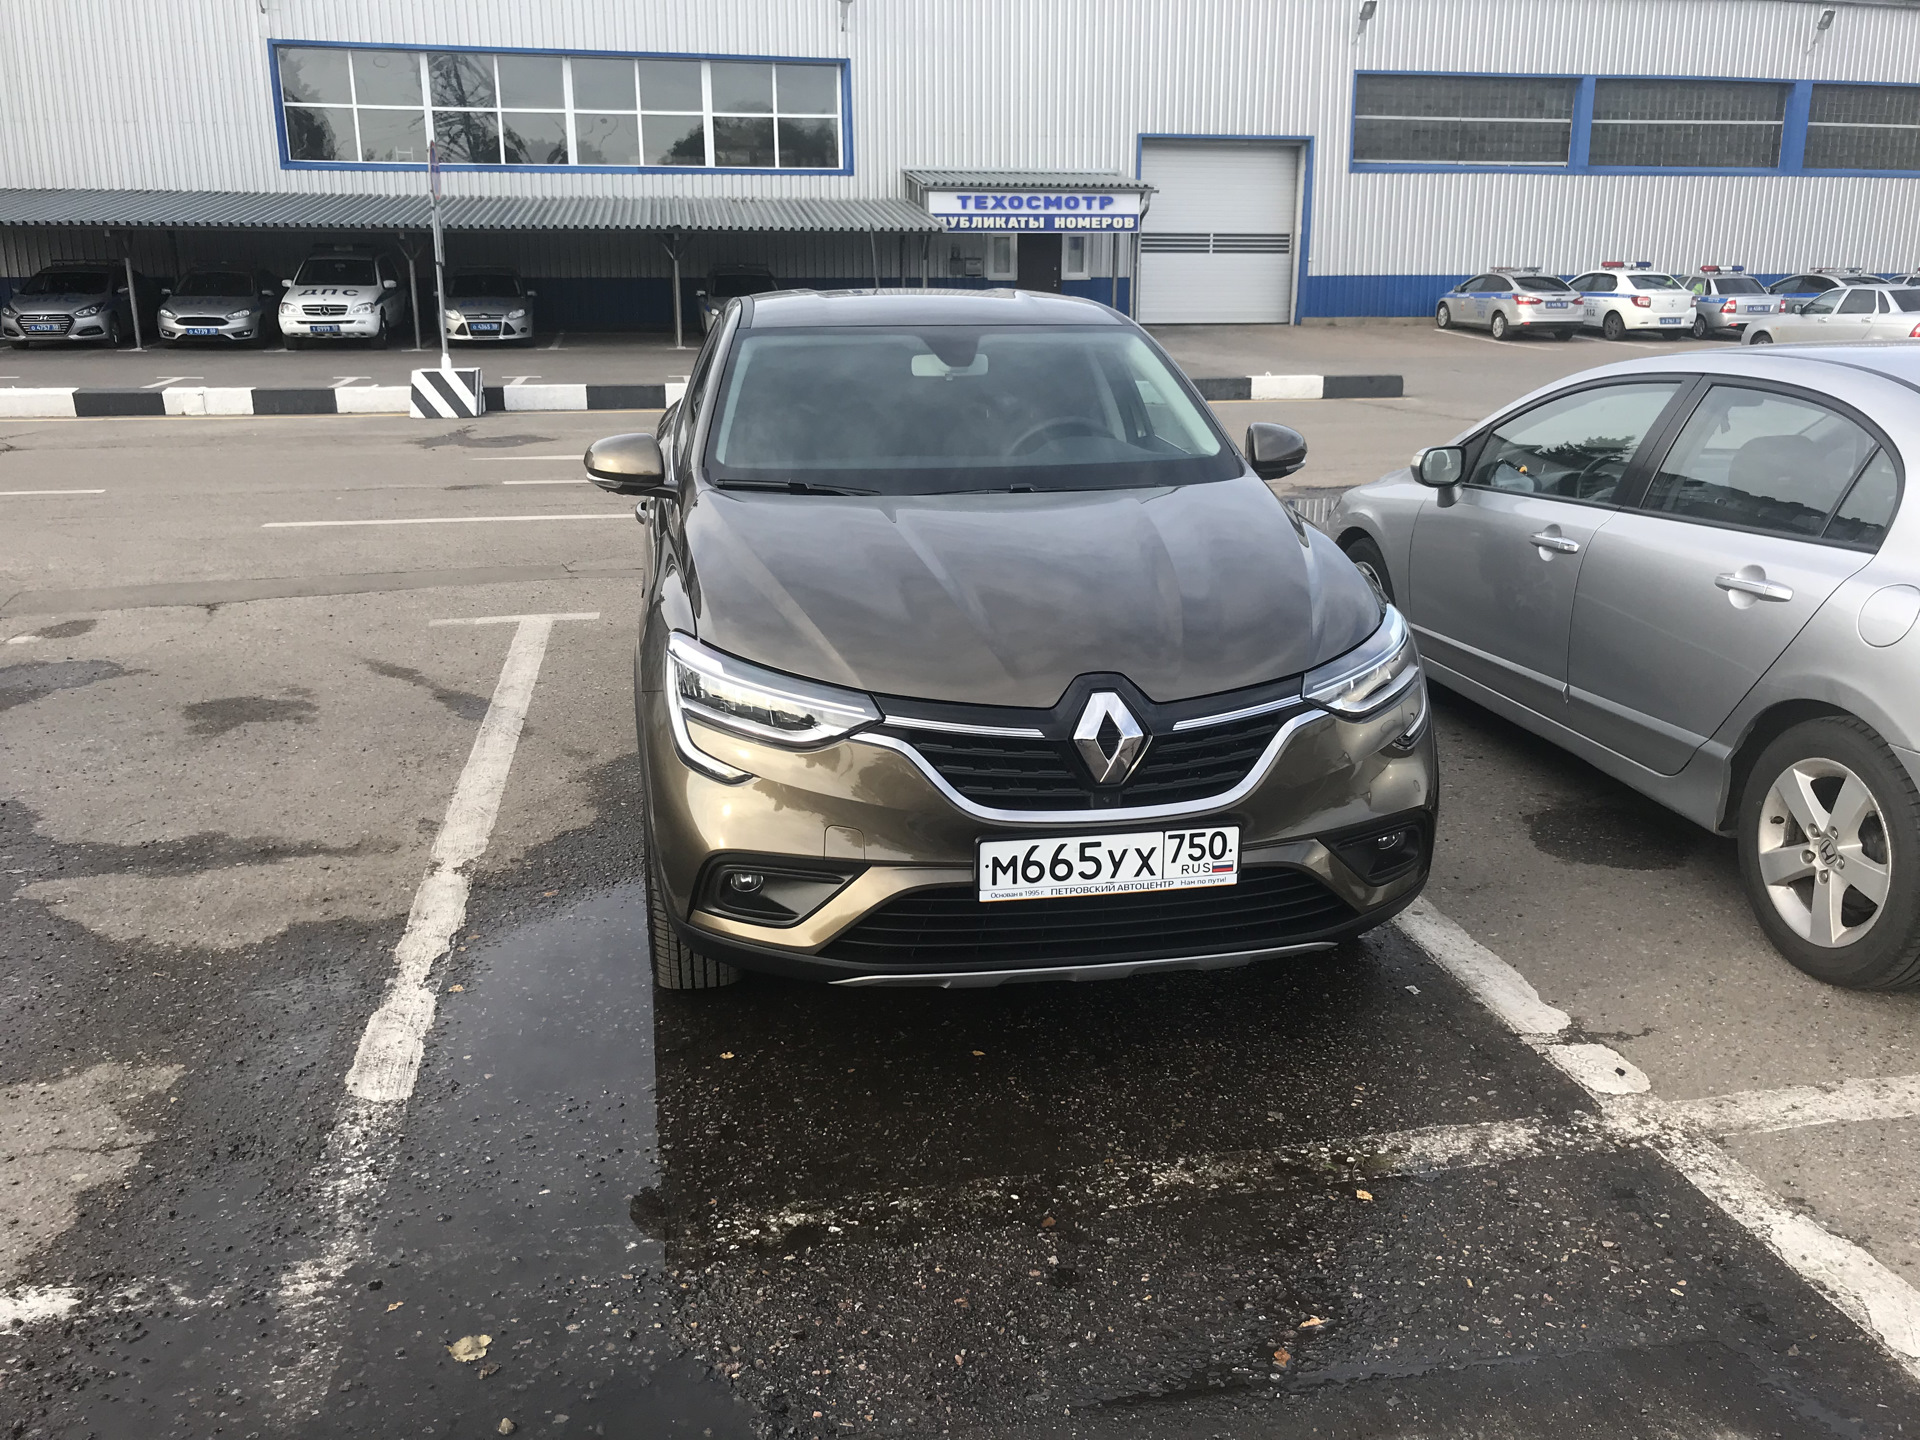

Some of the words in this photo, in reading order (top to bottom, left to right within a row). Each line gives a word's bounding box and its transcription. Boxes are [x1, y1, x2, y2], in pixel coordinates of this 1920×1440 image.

[957, 195, 1114, 210] ТЕХОСМОТР
[1054, 216, 1135, 229] НОМЕРОВ
[298, 288, 359, 297] ДПС
[1168, 831, 1228, 863] 750
[1181, 862, 1211, 875] RUS
[990, 891, 1018, 899] Основан
[1050, 884, 1116, 896] ПЕТРОВСКИЙ
[1117, 881, 1175, 892] АВТОЦЕНТР
[1207, 877, 1227, 885] пути!
